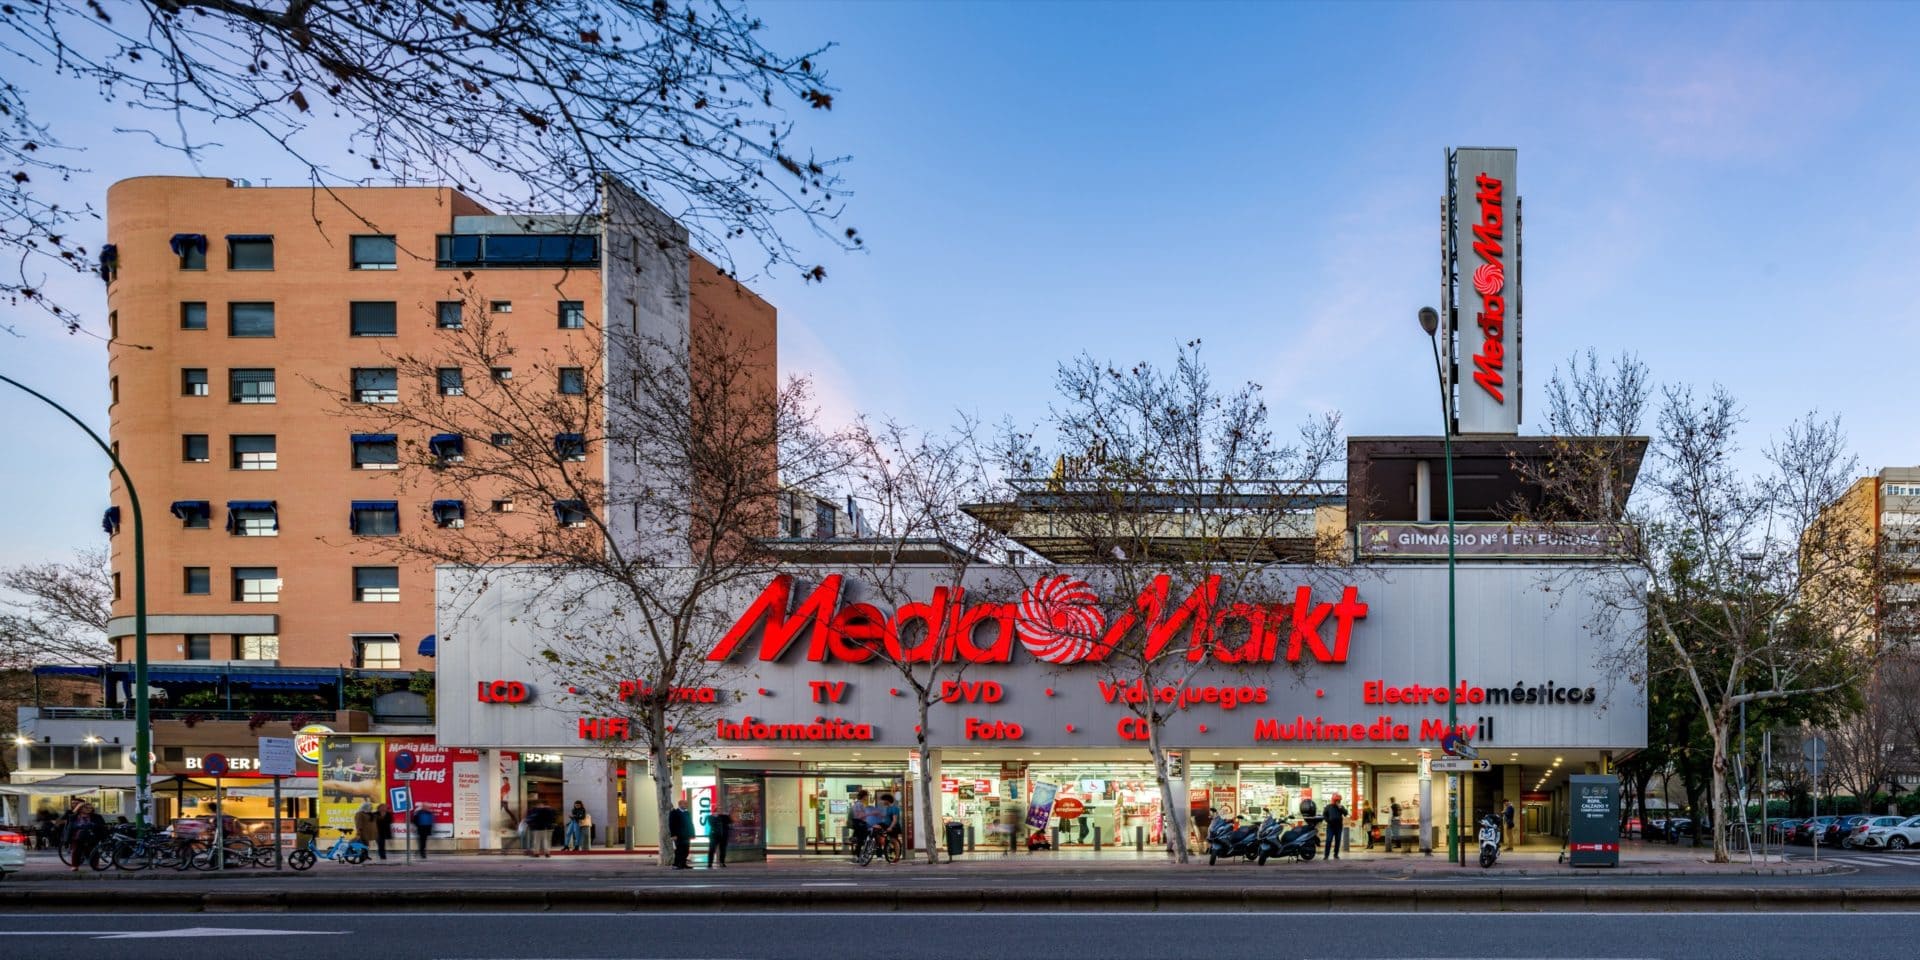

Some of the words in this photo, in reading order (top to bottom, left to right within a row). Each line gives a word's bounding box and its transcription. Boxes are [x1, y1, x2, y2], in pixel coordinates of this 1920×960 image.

[1472, 172, 1504, 270] Markt
[1472, 294, 1505, 403] Media
[1398, 533, 1476, 546] GIMNASIO
[1501, 534, 1508, 545] 1
[1512, 534, 1534, 545] EN
[707, 574, 1015, 663] Media
[1086, 574, 1369, 663] Markt
[478, 680, 526, 703] LCD
[809, 681, 845, 703] TV
[941, 680, 1003, 703] DVD
[1363, 680, 1595, 704] Electrodomésticos
[578, 717, 628, 740] HiFi
[717, 716, 871, 740] Informática
[965, 717, 1023, 740] Foto
[1254, 716, 1409, 741] Multimedia
[299, 741, 320, 754] KIN
[421, 754, 445, 764] justa
